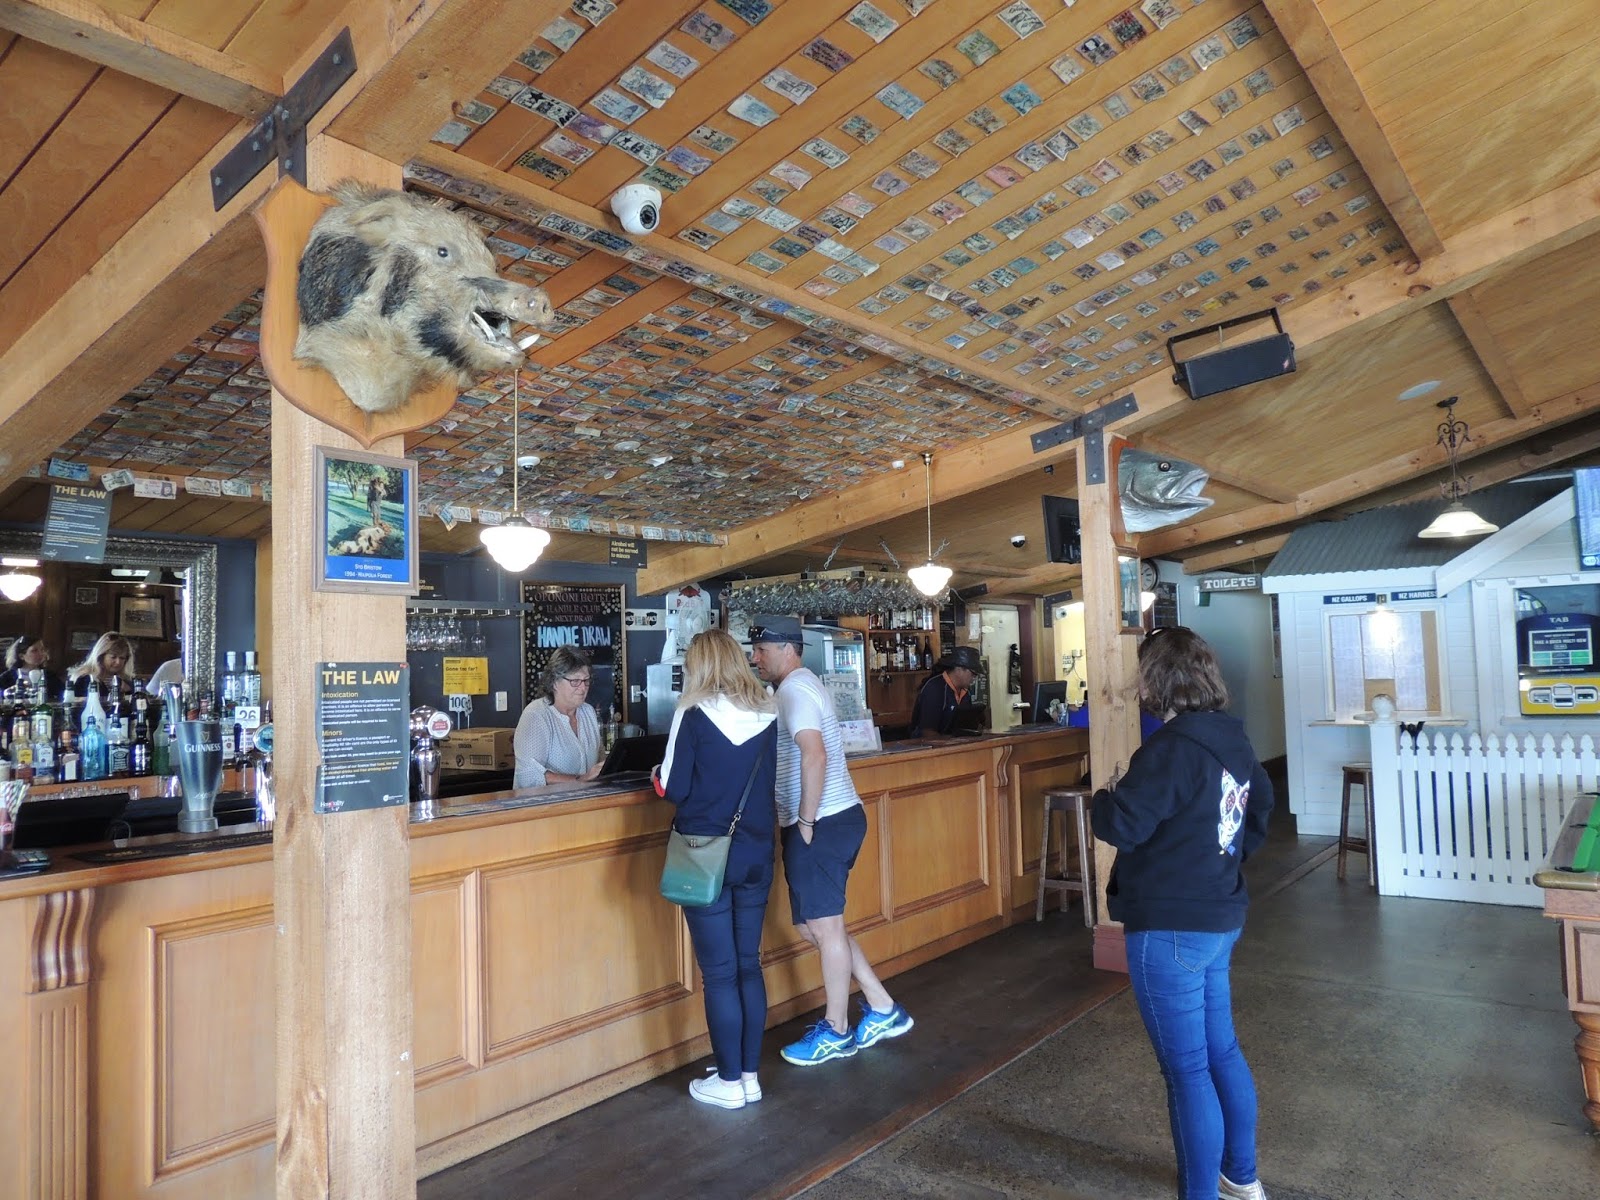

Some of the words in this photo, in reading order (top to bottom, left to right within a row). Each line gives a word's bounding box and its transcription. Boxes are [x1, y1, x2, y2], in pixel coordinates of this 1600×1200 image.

[54, 485, 78, 495] THE
[80, 488, 107, 499] LAW
[1204, 576, 1256, 589] TOILETS
[581, 626, 611, 647] DRAW
[322, 671, 357, 685] THE
[362, 670, 400, 684] LAW
[184, 743, 221, 753] GUINNESS
